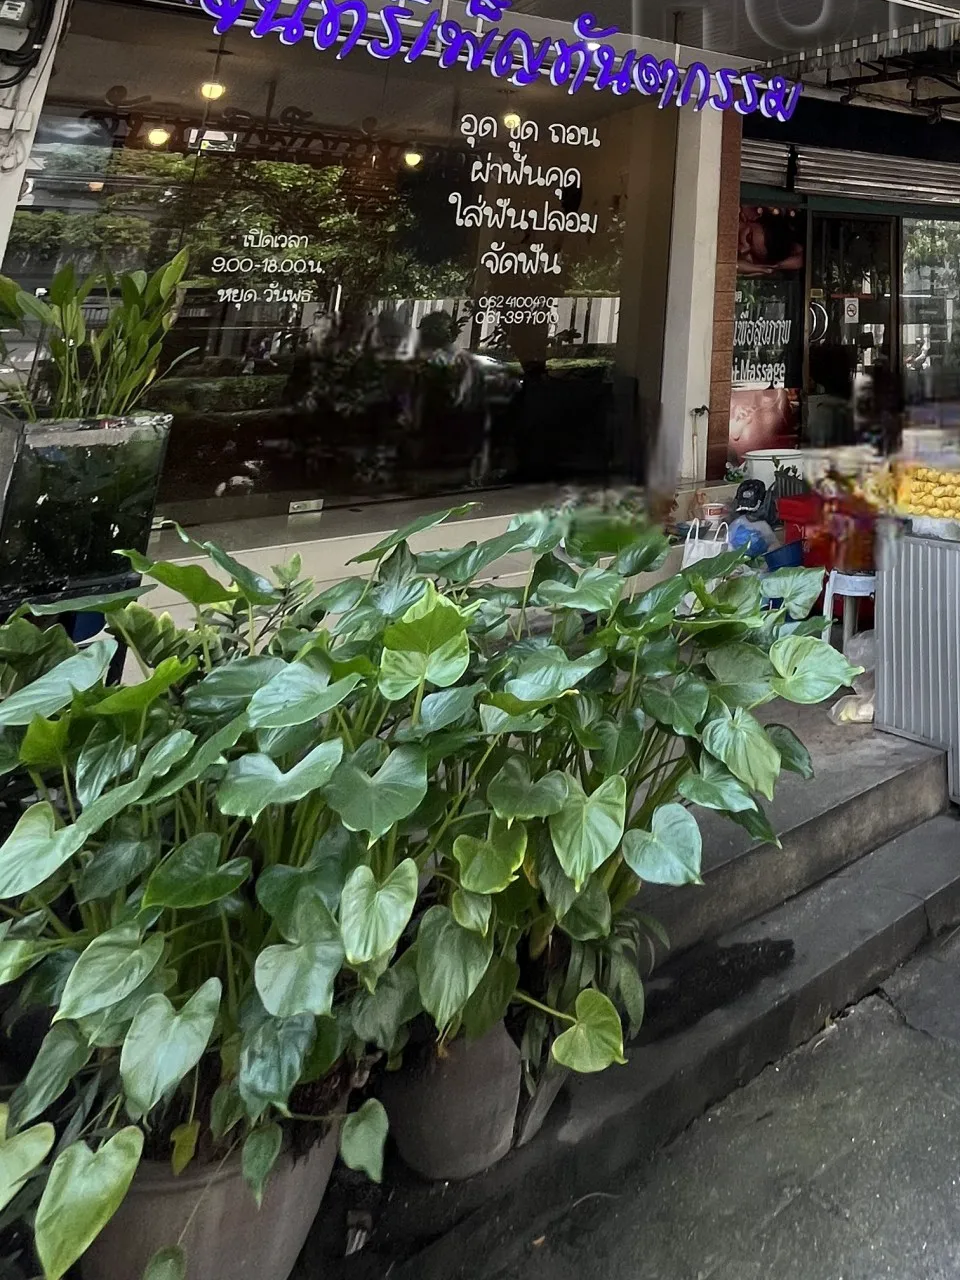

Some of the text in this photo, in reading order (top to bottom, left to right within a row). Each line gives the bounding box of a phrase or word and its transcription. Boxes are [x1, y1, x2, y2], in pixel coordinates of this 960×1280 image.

[460, 114, 497, 148] อุด
[548, 123, 600, 148] ถอน
[471, 152, 581, 200] ผ่าฟันคุด
[448, 192, 598, 233] ใส่ฟันปลอม
[243, 228, 308, 248] เปิดเวลา
[481, 242, 561, 275] จัดฟัน
[217, 287, 257, 311] หยุด
[740, 360, 786, 386] Massage
